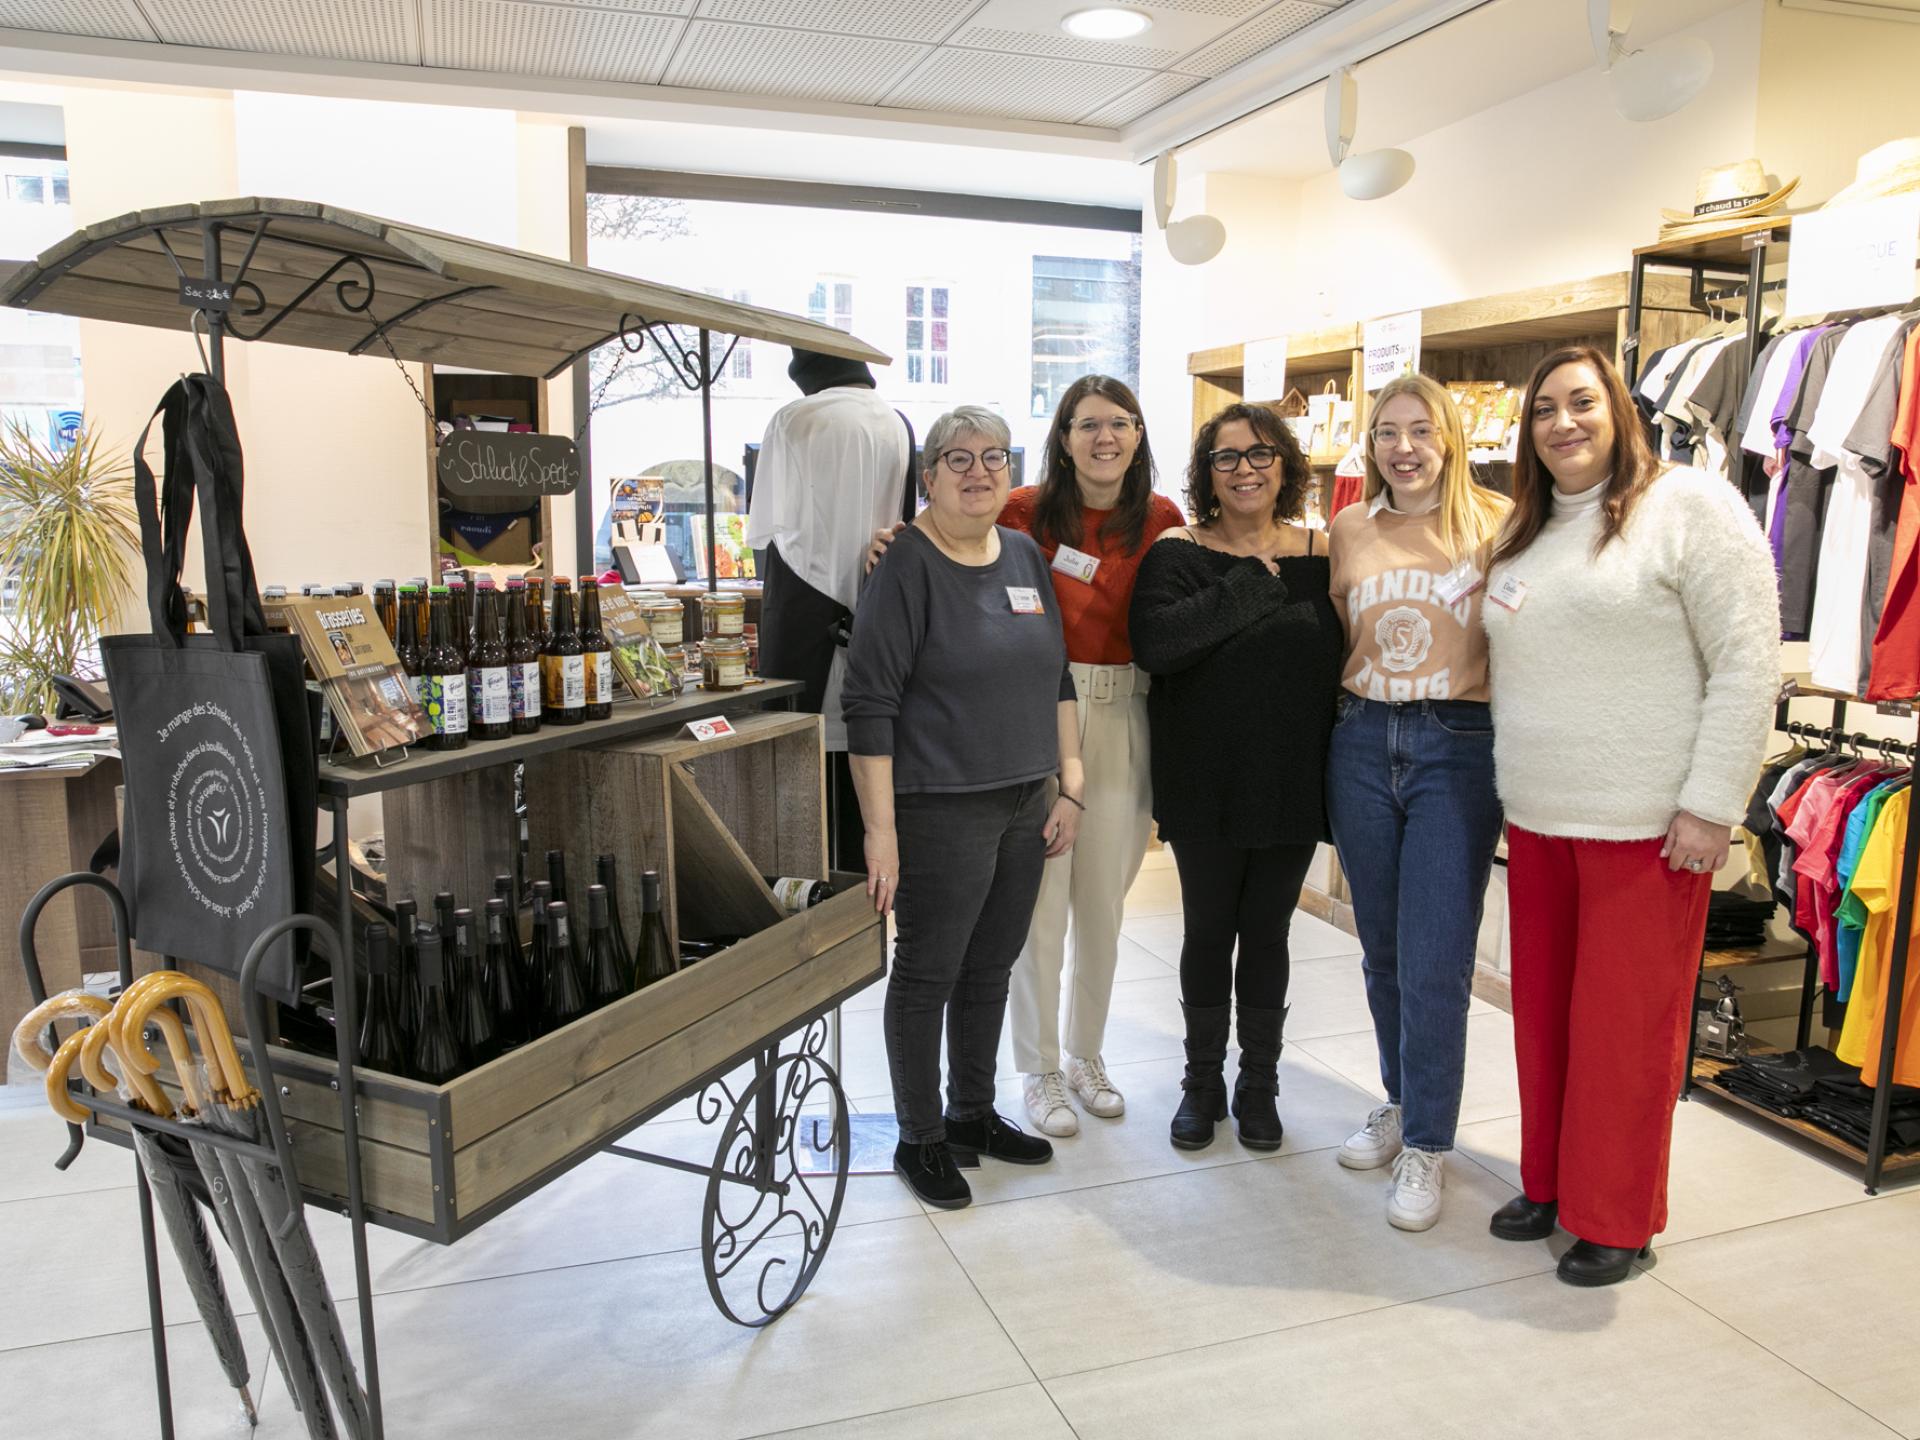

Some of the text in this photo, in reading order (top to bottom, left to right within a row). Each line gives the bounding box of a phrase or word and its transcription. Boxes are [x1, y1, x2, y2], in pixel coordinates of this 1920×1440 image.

[1705, 201, 1731, 213] chaud
[1733, 199, 1742, 208] la
[185, 286, 203, 298] Sac
[1368, 343, 1400, 361] PRODUITS
[1368, 360, 1395, 376] TERROIR
[315, 606, 367, 630] Brasseries
[193, 702, 206, 716] des
[167, 708, 193, 732] mange
[157, 729, 169, 743] Je
[199, 741, 206, 754] la
[186, 749, 201, 762] dans
[170, 759, 188, 790] rutsche
[168, 788, 178, 801] je
[168, 799, 176, 810] et
[168, 811, 179, 851] schnaps
